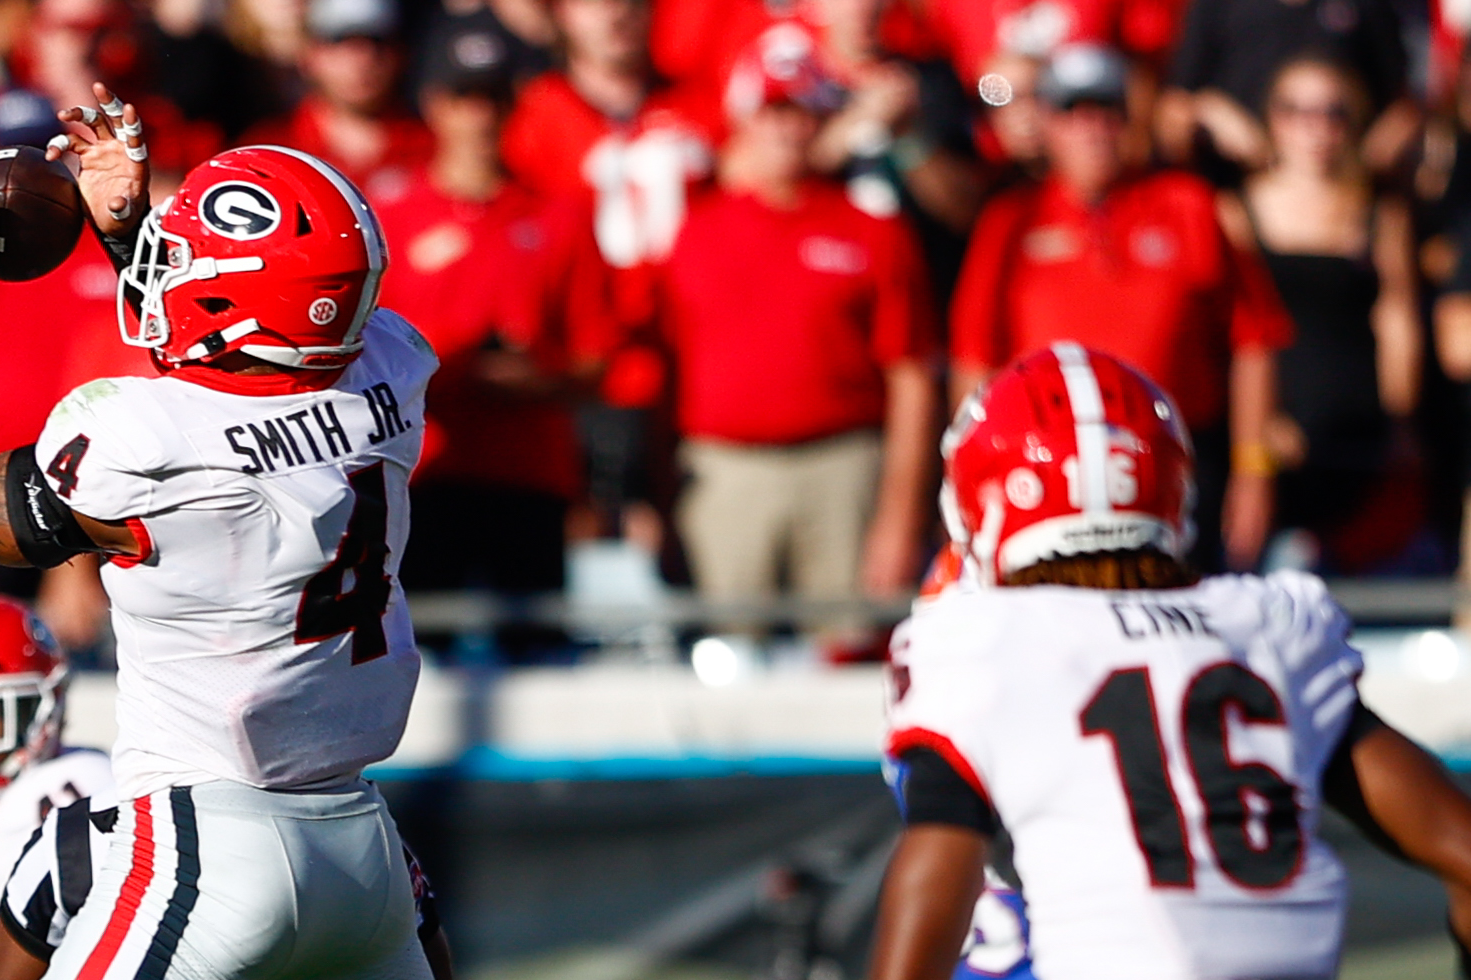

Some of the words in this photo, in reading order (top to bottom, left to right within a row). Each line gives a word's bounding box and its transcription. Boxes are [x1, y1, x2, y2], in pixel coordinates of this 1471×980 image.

[201, 183, 278, 237] G
[45, 432, 91, 501] 4
[224, 401, 353, 476] SMITH
[362, 381, 412, 446] JR.
[293, 459, 392, 667] 4
[1078, 659, 1306, 893] 16
